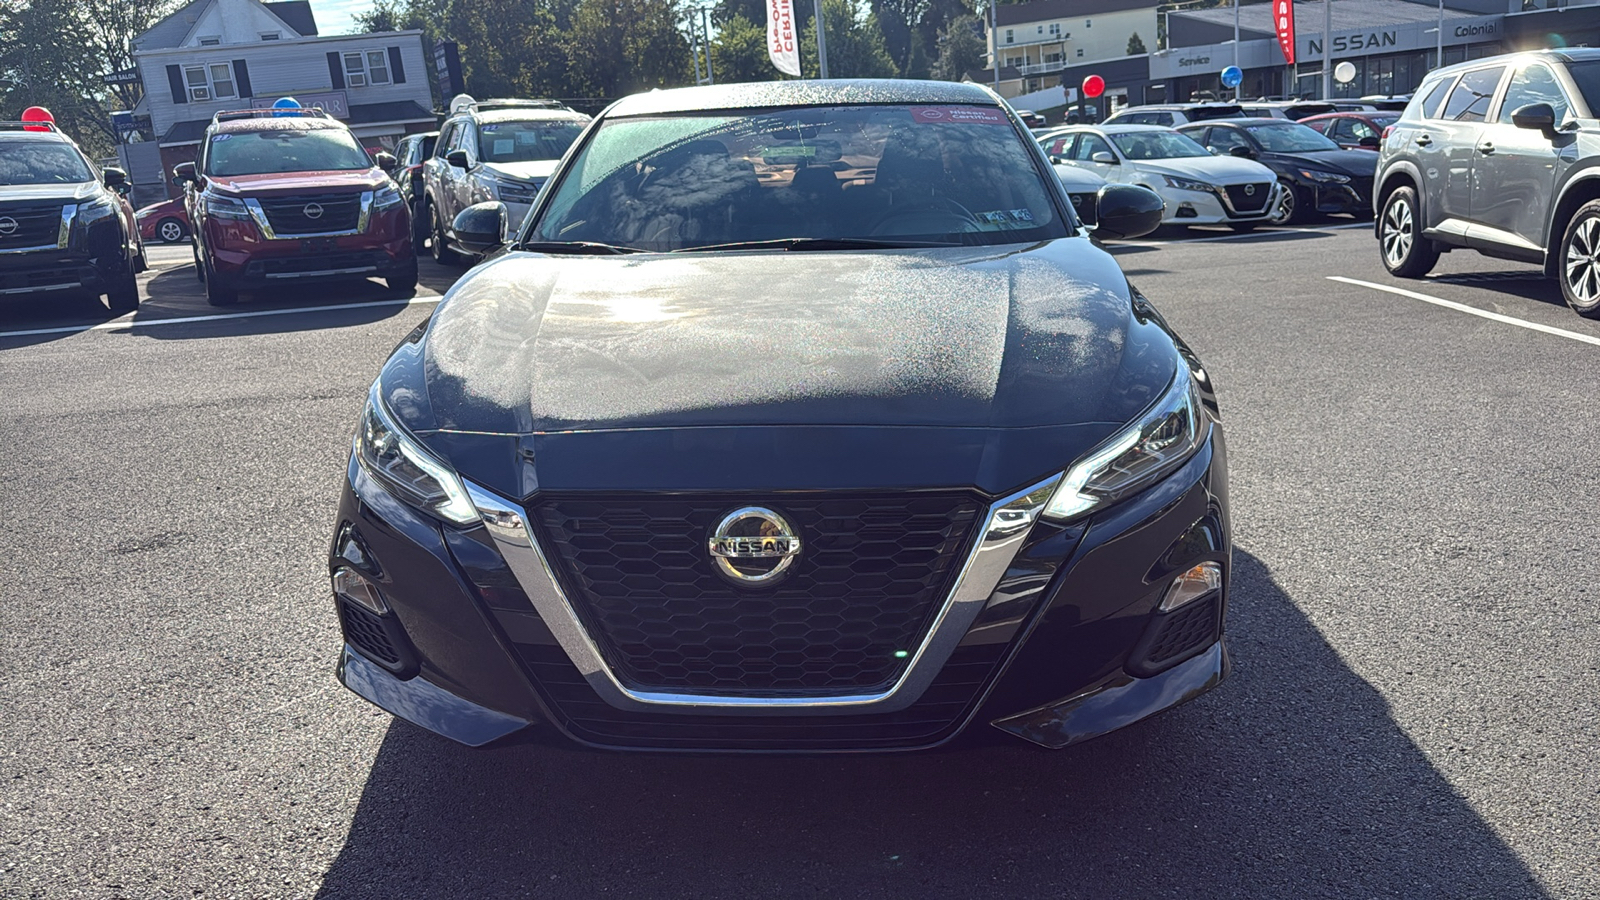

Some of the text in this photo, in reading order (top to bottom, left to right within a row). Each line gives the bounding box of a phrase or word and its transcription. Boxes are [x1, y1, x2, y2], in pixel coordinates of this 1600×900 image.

[1454, 22, 1497, 37] Colonial
[1308, 31, 1396, 55] NSSAN
[1178, 55, 1210, 67] Service
[118, 73, 137, 81] SALON
[717, 540, 790, 553] NISSAN
